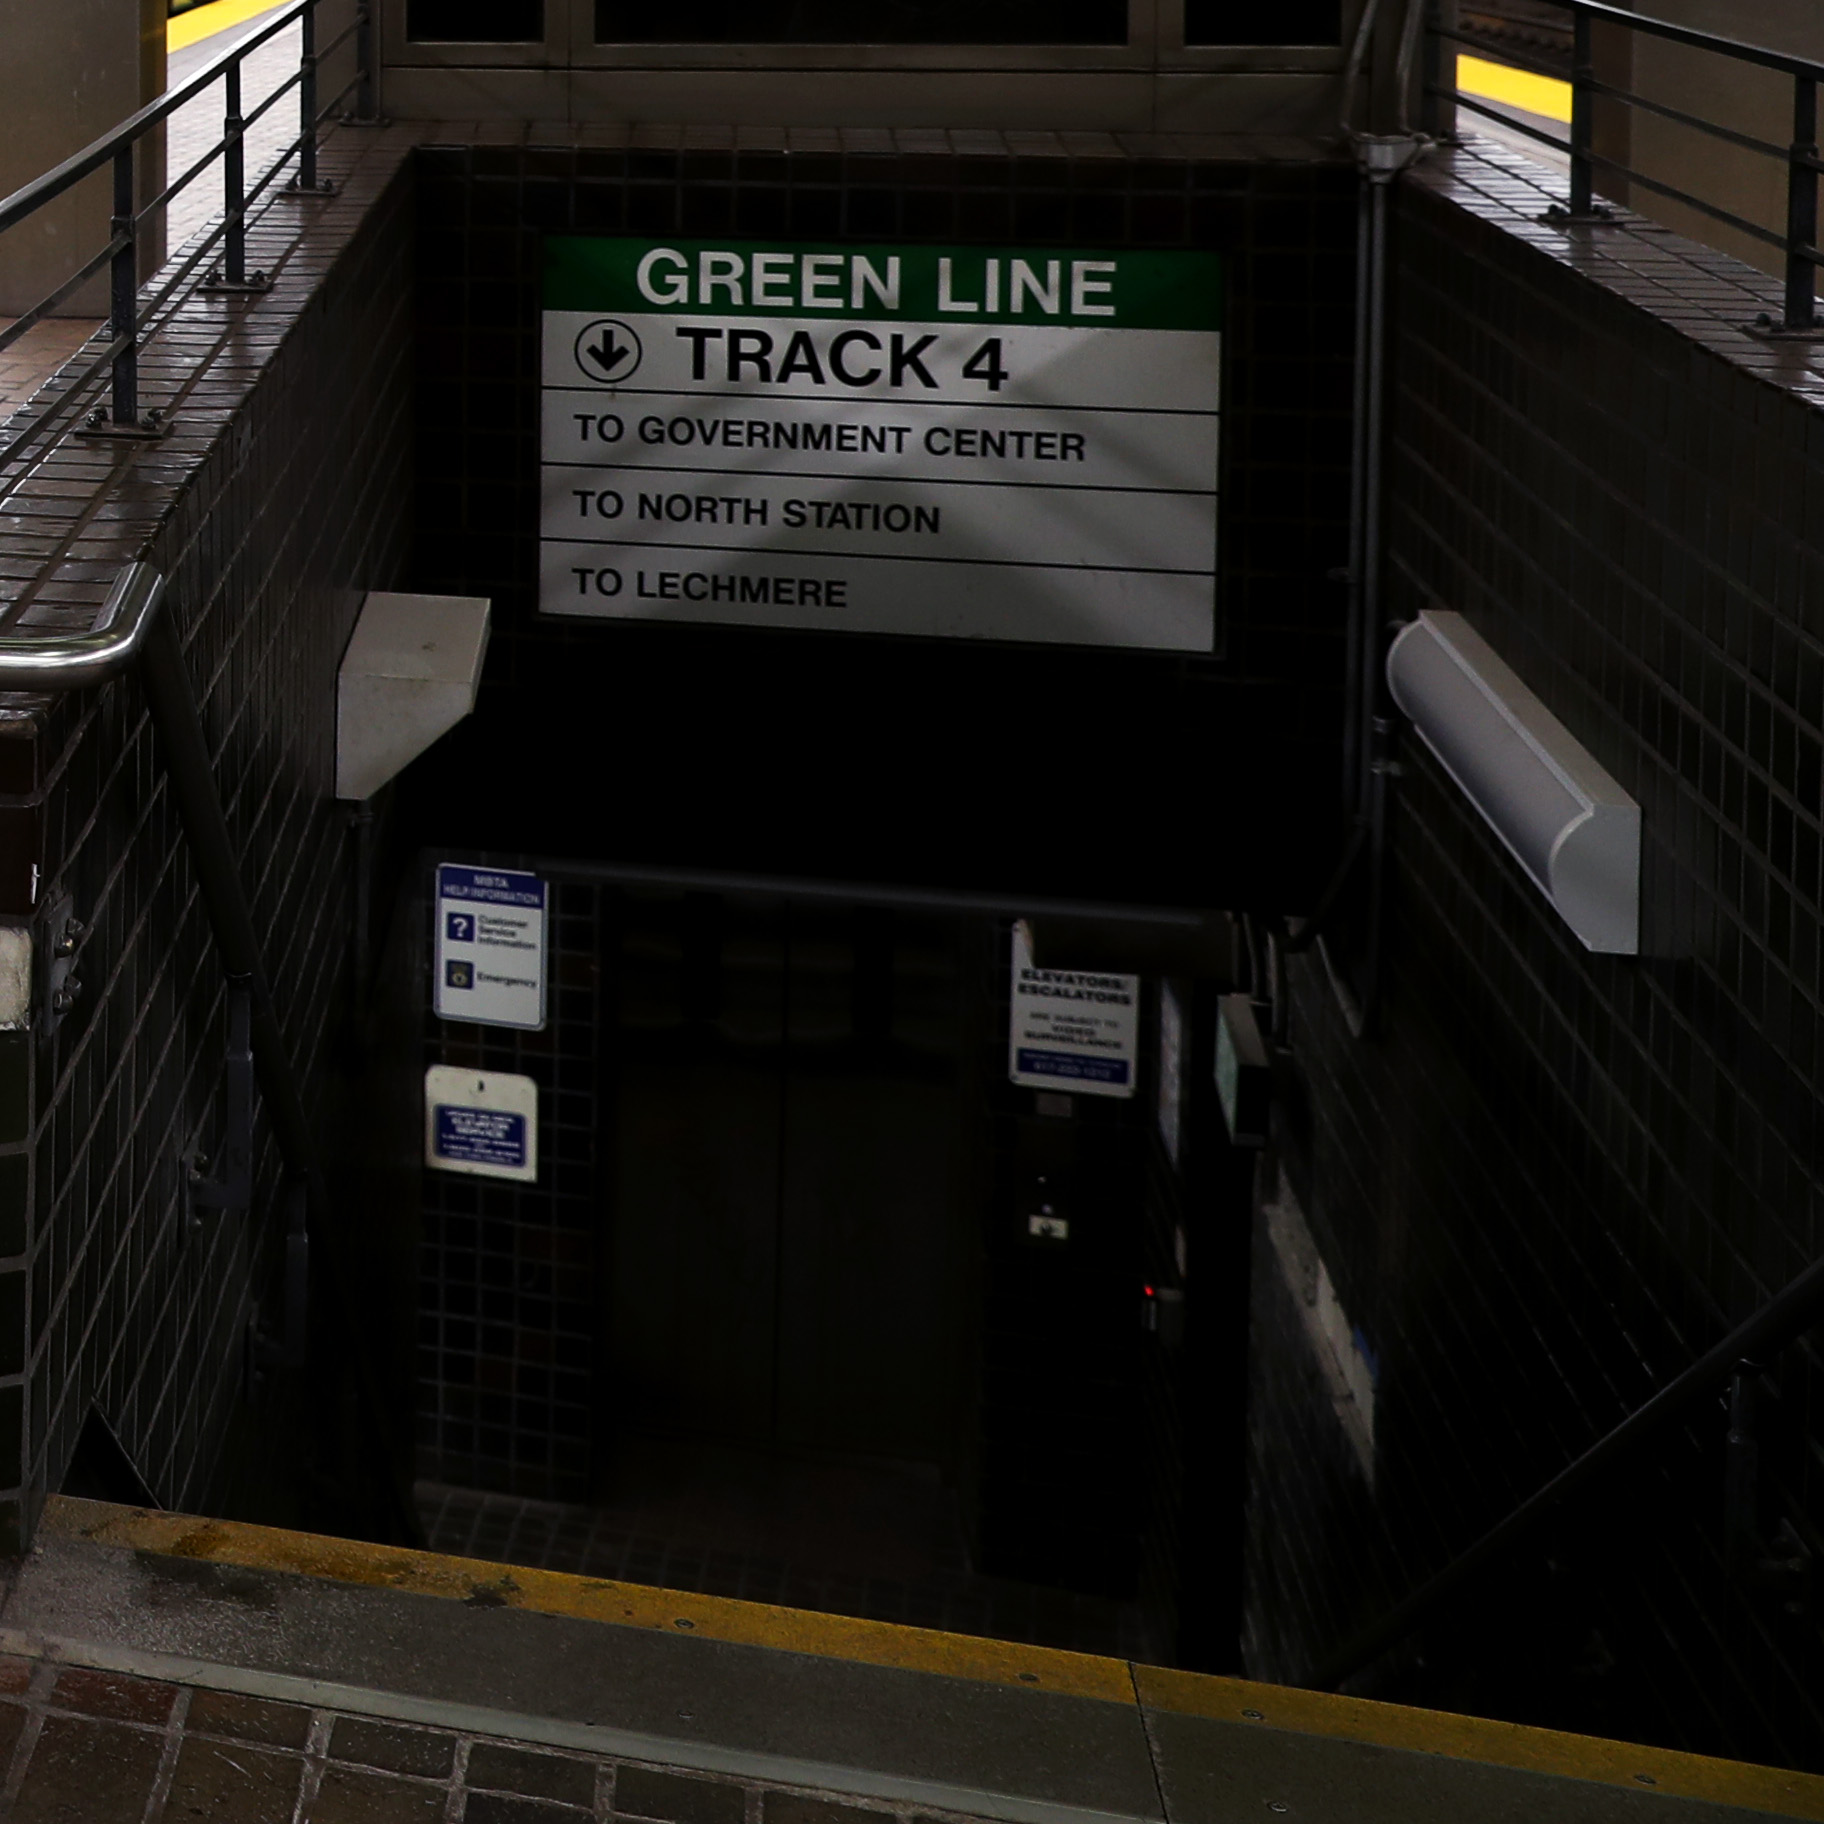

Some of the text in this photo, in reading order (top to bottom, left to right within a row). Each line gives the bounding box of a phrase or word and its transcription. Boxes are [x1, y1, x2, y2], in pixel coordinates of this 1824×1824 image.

[636, 246, 1118, 318] GREEN LINE
[677, 327, 1009, 392] TRACK 4
[574, 414, 1085, 461] TO GOVERNMENT CENTER
[573, 490, 941, 534] TO NORTH STATION
[573, 567, 848, 608] TO LECHMERE
[1018, 983, 1131, 1005] ESCALATORS
